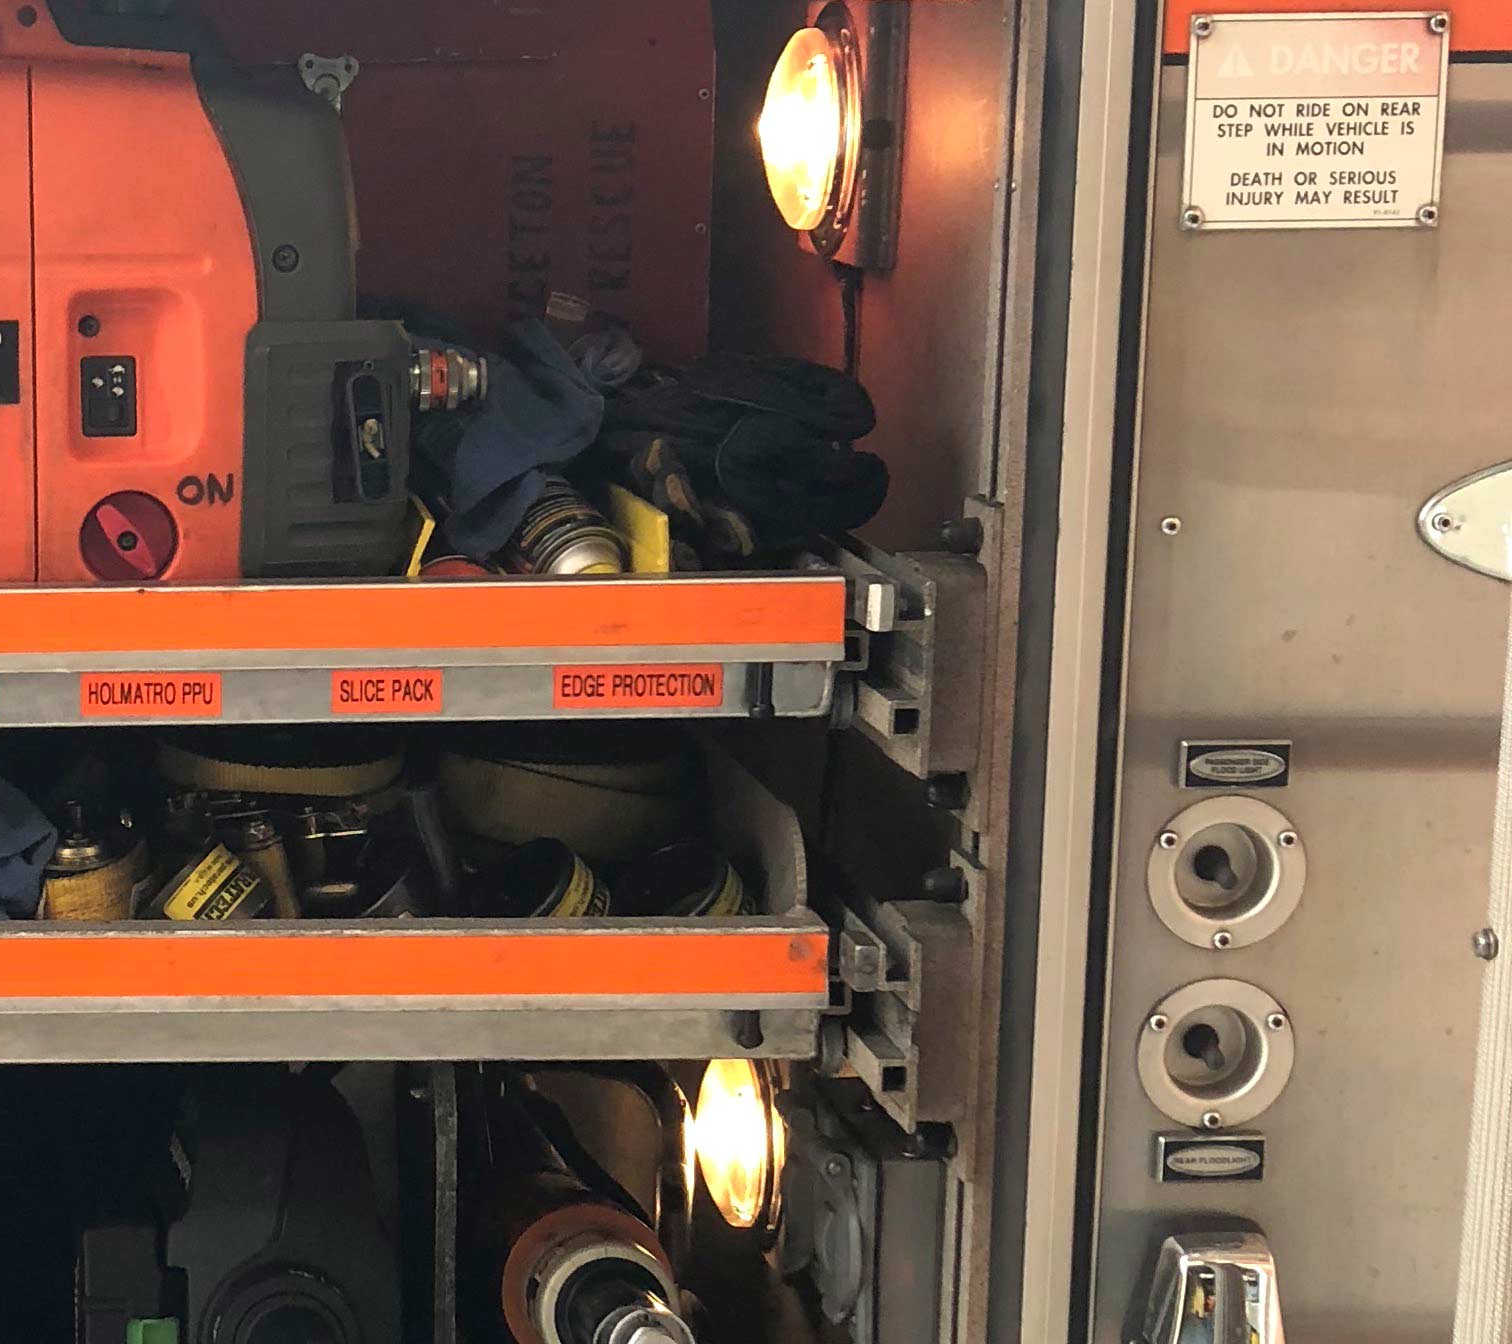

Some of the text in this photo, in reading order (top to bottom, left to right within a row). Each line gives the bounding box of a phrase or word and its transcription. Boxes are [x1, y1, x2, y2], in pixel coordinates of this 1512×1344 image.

[1271, 42, 1421, 75] DANGER
[1212, 101, 1421, 119] DO NOT RIDE ON REAR
[1216, 120, 1415, 138] STEP WHILE VEHICLE IS
[1266, 141, 1365, 156] IN MOTION
[1230, 170, 1397, 187] DEATH OR SERIOUS
[1225, 189, 1399, 206] INJURY MAY RESULT
[176, 472, 235, 505] ON
[88, 682, 213, 705] HOLMATRO PPU
[339, 678, 434, 702] SLICE PACK
[560, 673, 715, 697] EDGE PROTECTION
